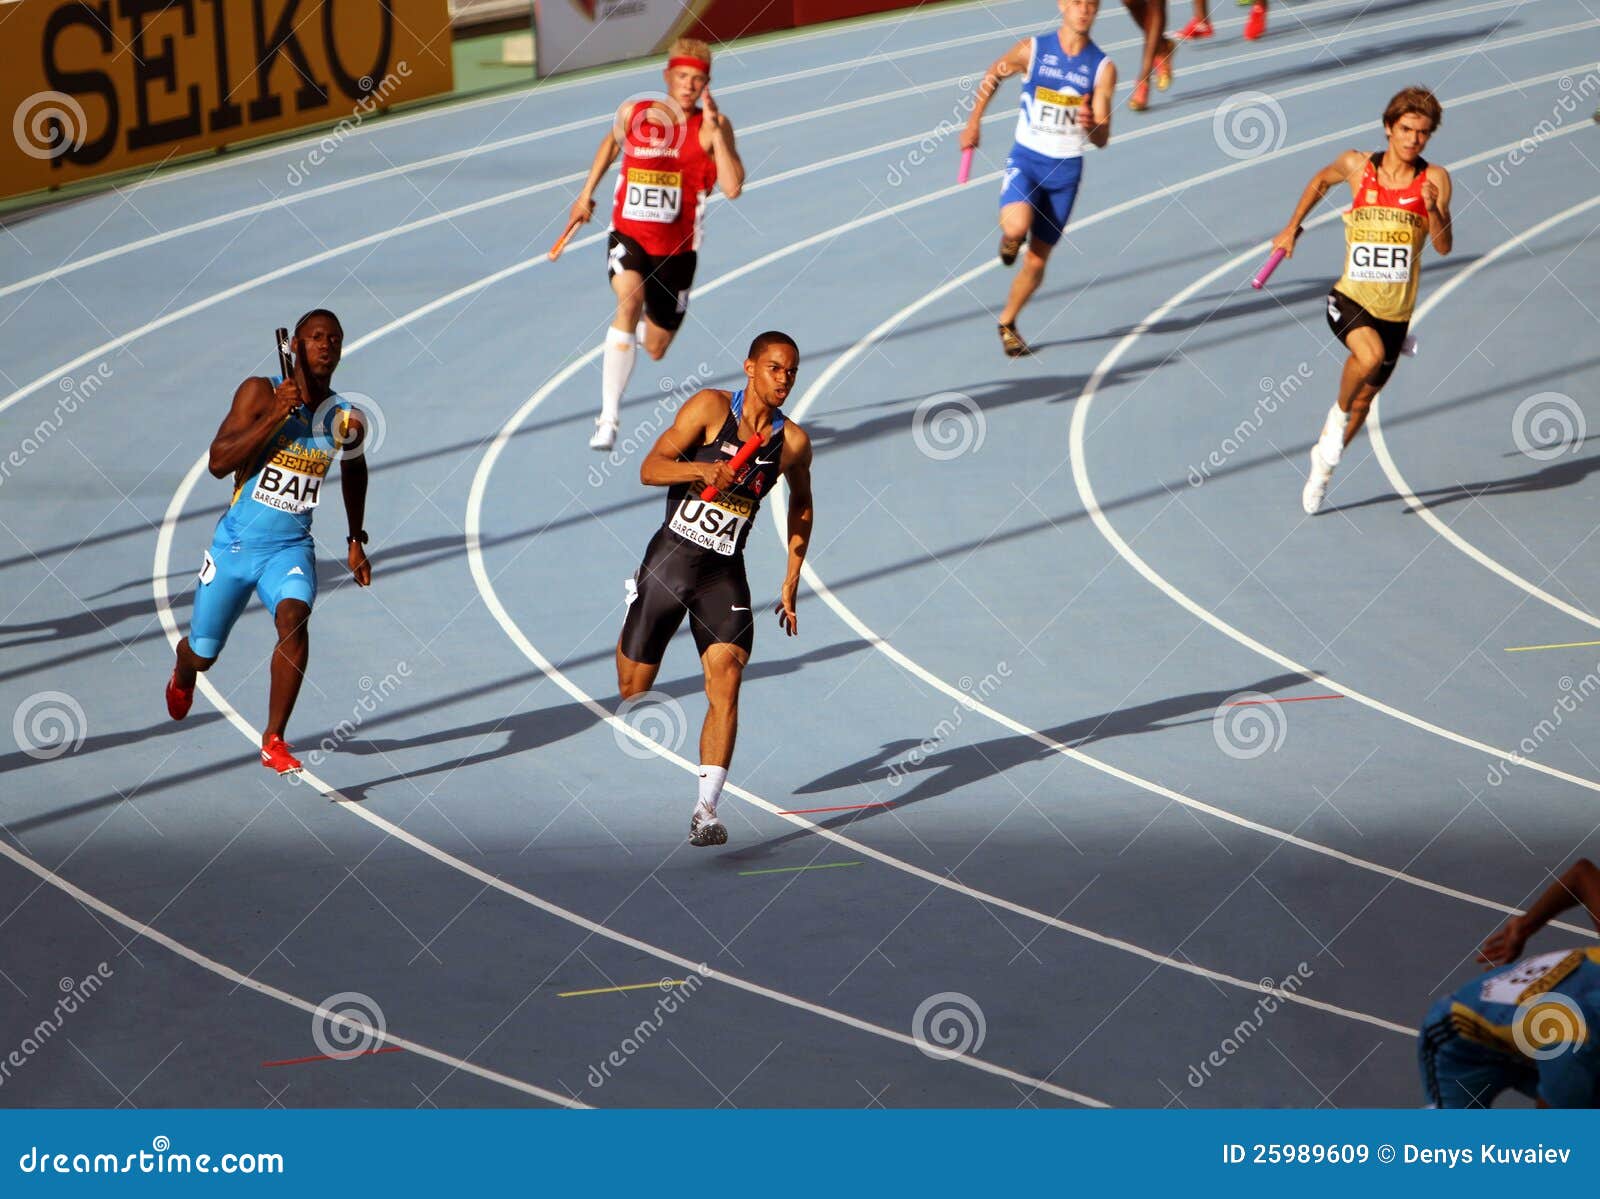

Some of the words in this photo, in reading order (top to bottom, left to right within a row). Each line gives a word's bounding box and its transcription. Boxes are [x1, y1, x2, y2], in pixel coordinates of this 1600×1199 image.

[42, 0, 394, 169] SEIKO
[1040, 105, 1077, 125] FIN
[628, 170, 679, 186] SEIKO
[629, 186, 677, 210] DEN
[1354, 229, 1411, 243] SEIKO
[1353, 246, 1409, 268] GER
[270, 452, 327, 476] SEIKO
[258, 466, 320, 504] BAH
[254, 491, 298, 513] BARCELONA
[679, 494, 739, 542] USA
[671, 519, 715, 549] BARCELONA
[716, 542, 732, 554] 2012
